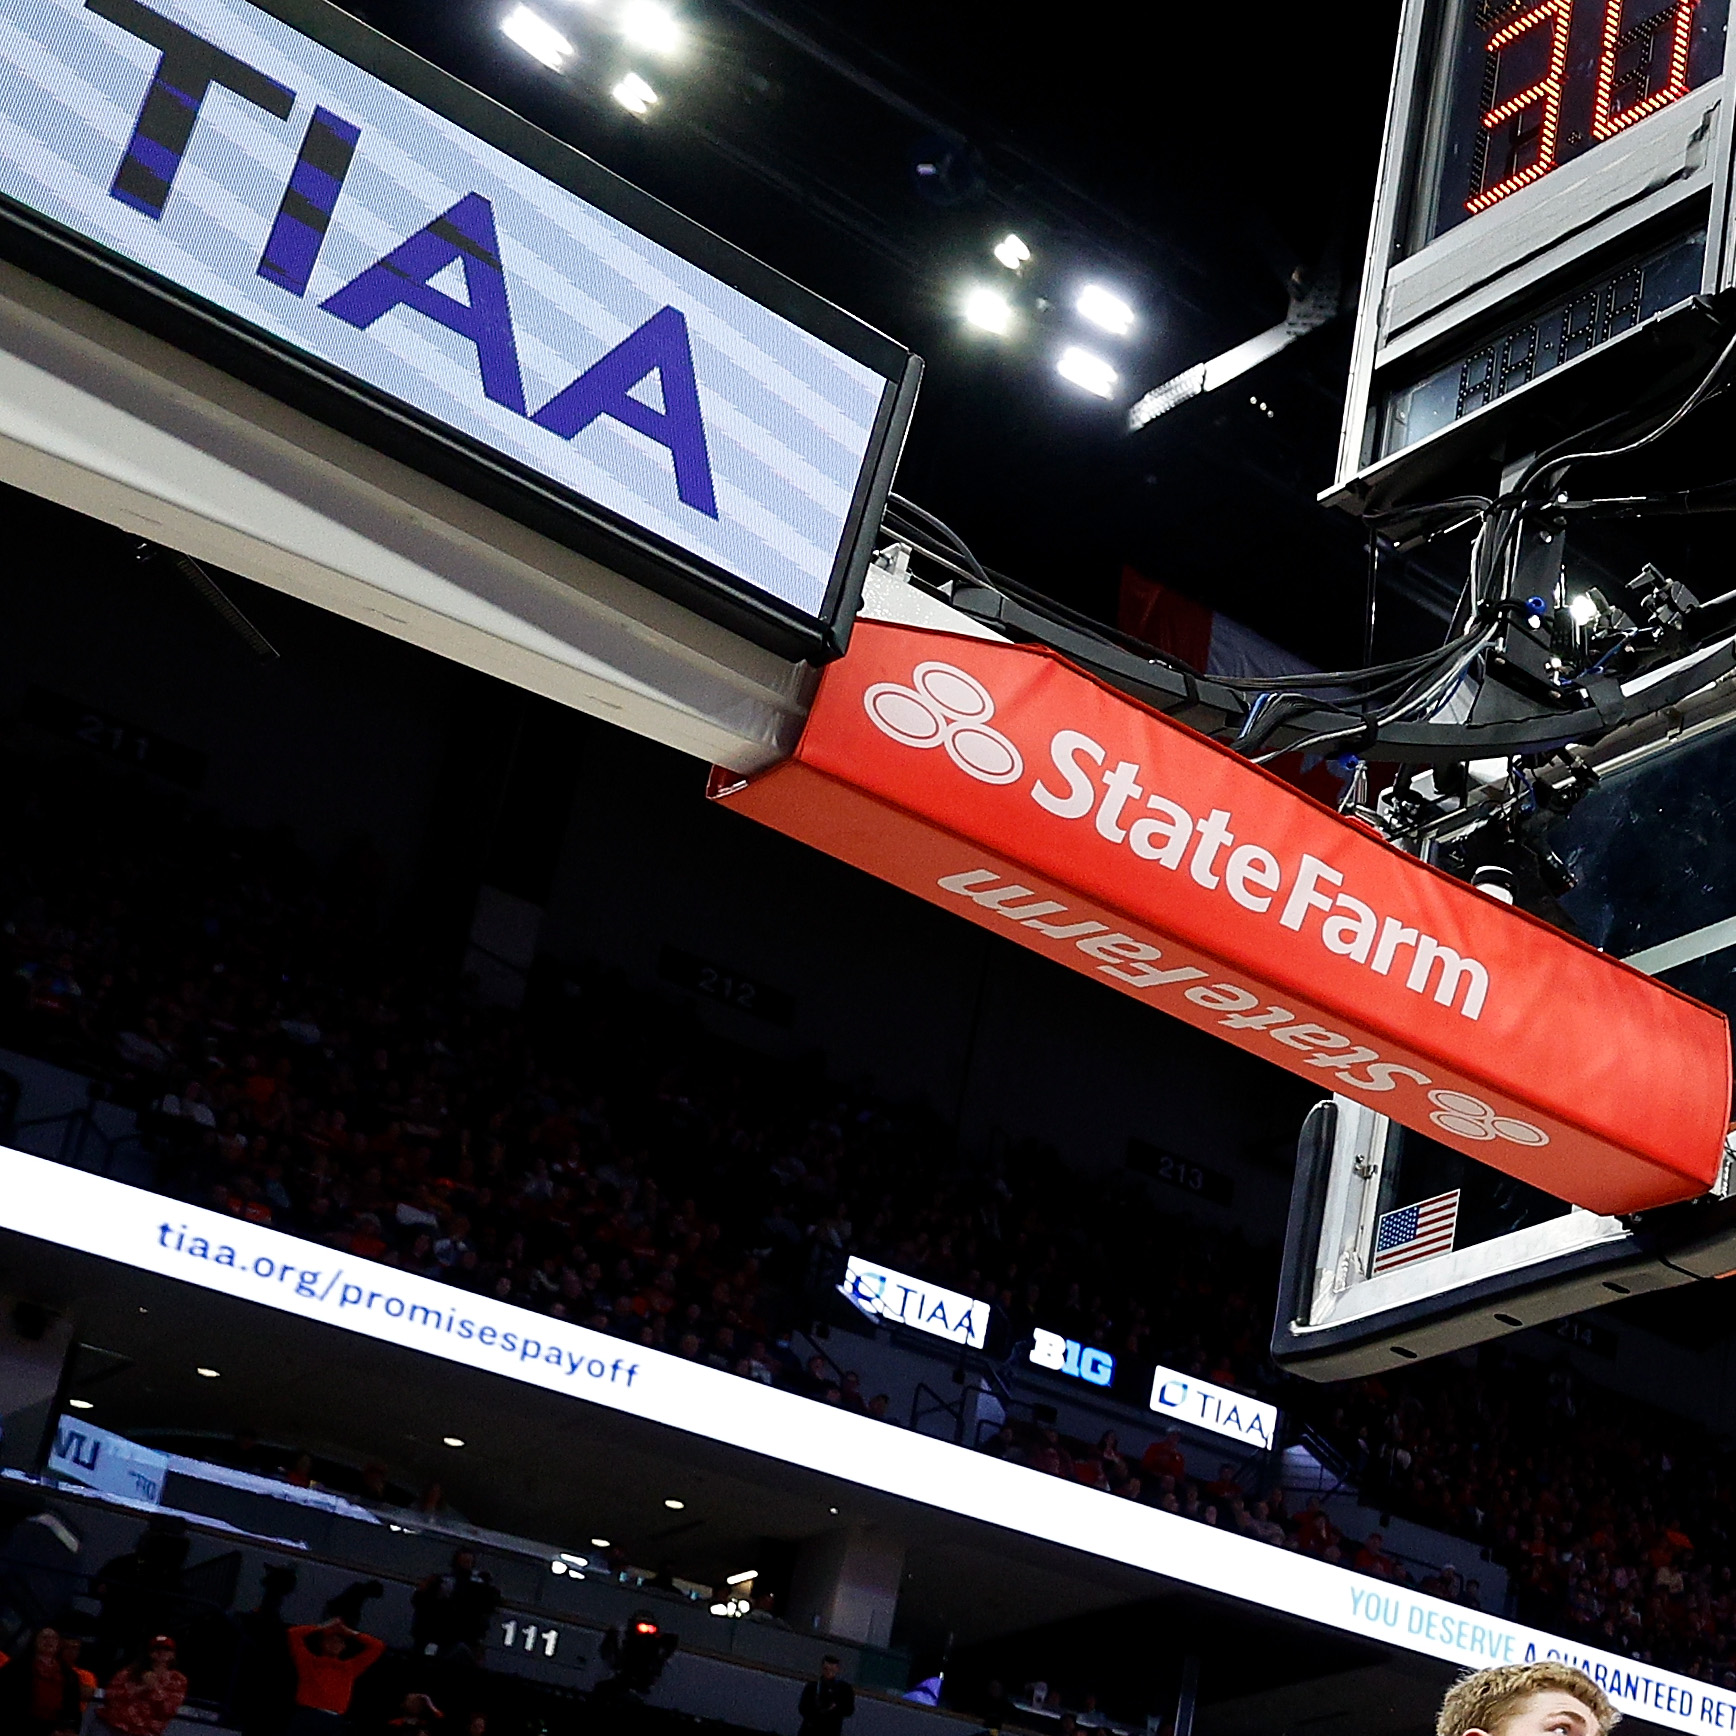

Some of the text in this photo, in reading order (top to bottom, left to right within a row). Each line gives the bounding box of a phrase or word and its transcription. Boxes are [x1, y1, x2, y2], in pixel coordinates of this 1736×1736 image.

[85, 0, 719, 520] TIAA
[1030, 728, 1490, 1020] StateFarm
[936, 867, 1432, 1092] StateFarm
[1156, 1153, 1205, 1192] 213
[155, 1219, 640, 1389] tiaa.org/promisespayoff
[894, 1283, 977, 1340] TIAA
[1196, 1389, 1269, 1439] TIAA
[500, 1618, 561, 1658] 111
[1350, 1585, 1400, 1629] YOU
[1407, 1604, 1518, 1664] DESERVE
[1524, 1641, 1537, 1664] A
